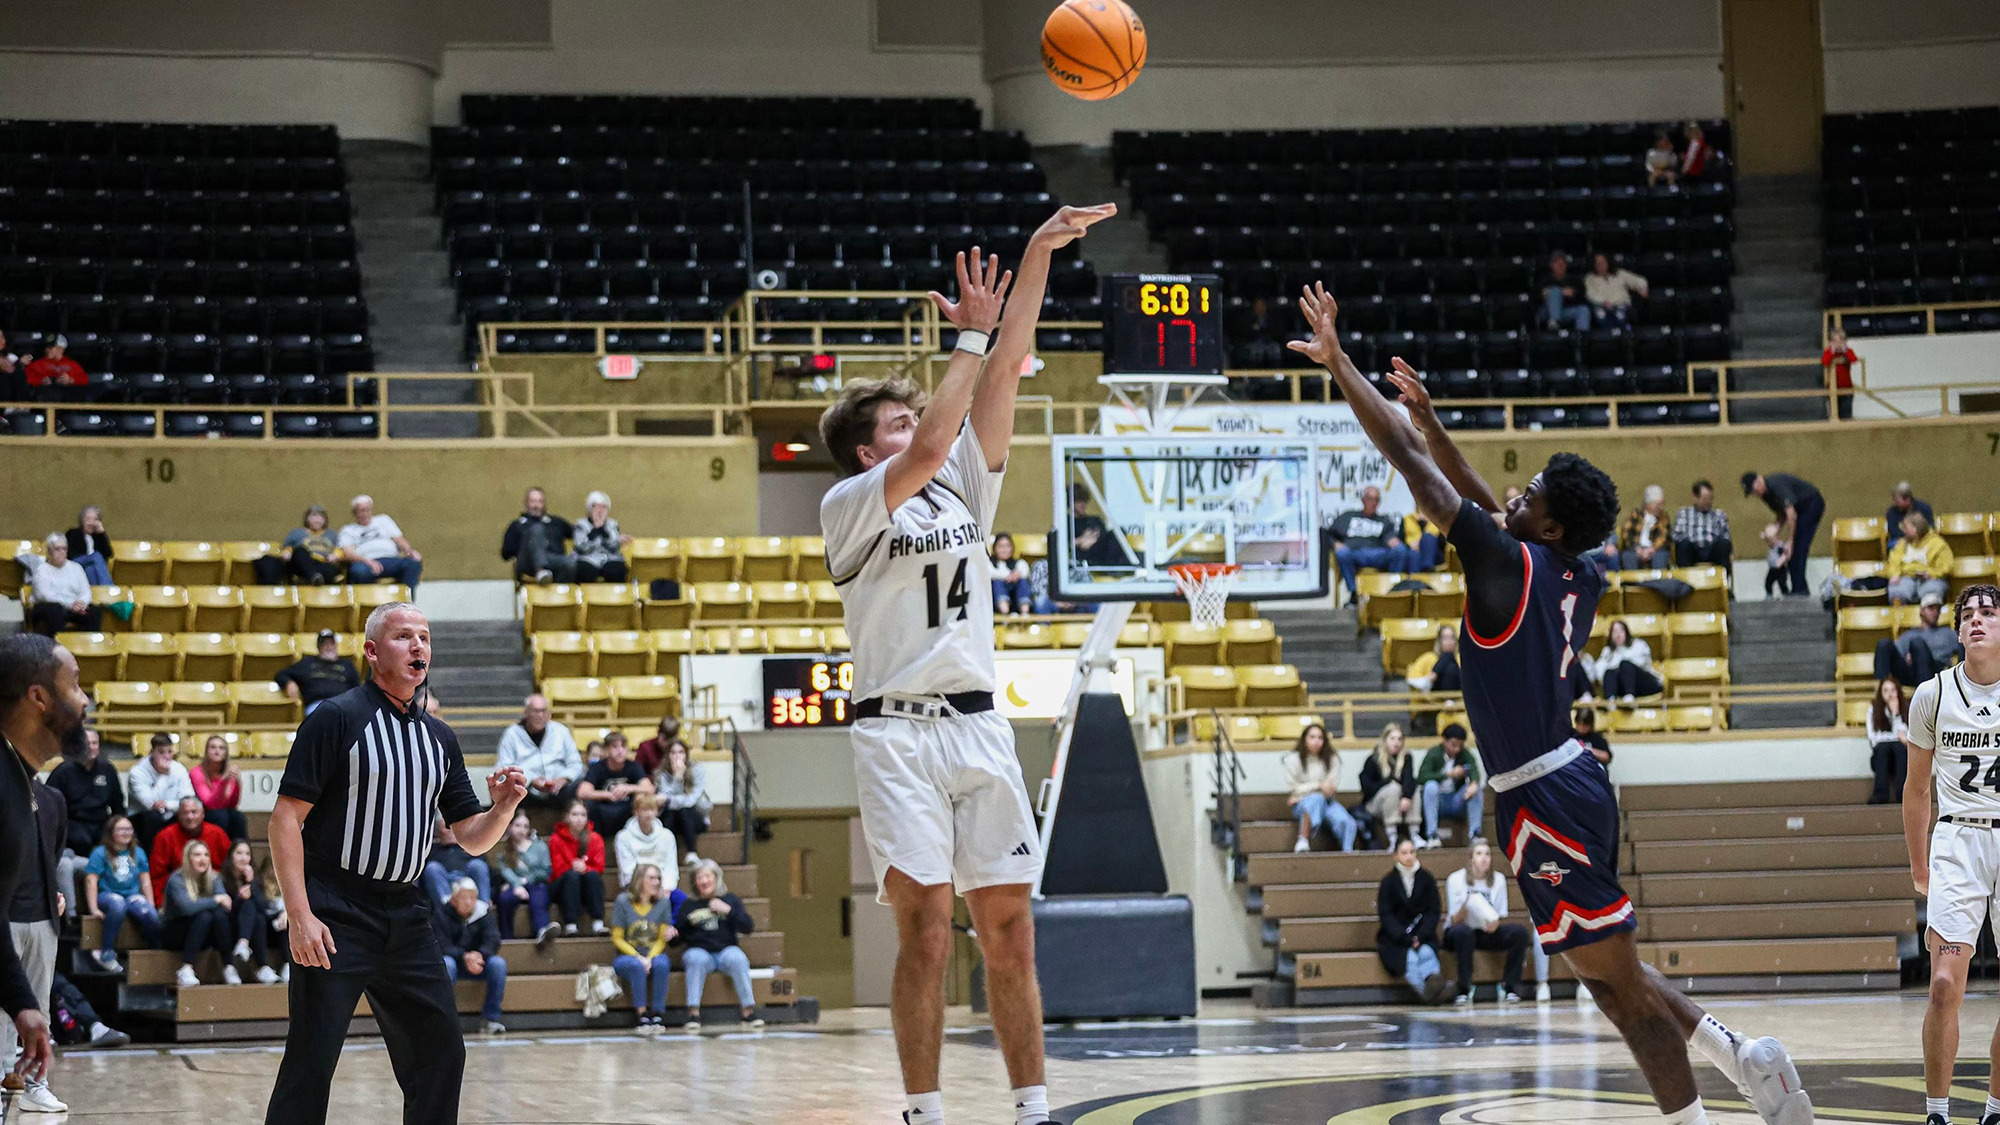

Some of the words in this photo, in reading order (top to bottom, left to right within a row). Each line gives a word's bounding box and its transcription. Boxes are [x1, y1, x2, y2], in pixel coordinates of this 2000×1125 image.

[1041, 46, 1083, 85] ilson
[1140, 283, 1209, 315] 6:01
[1158, 319, 1197, 366] 17
[1986, 432, 2000, 455] 7
[145, 457, 175, 483] 10
[710, 457, 726, 481] 9
[1504, 449, 1517, 472] 8
[921, 557, 970, 629] 14
[772, 697, 806, 724] 36
[1942, 732, 1990, 748] EMPORIA
[250, 774, 273, 795] 10
[1959, 754, 2000, 793] 24
